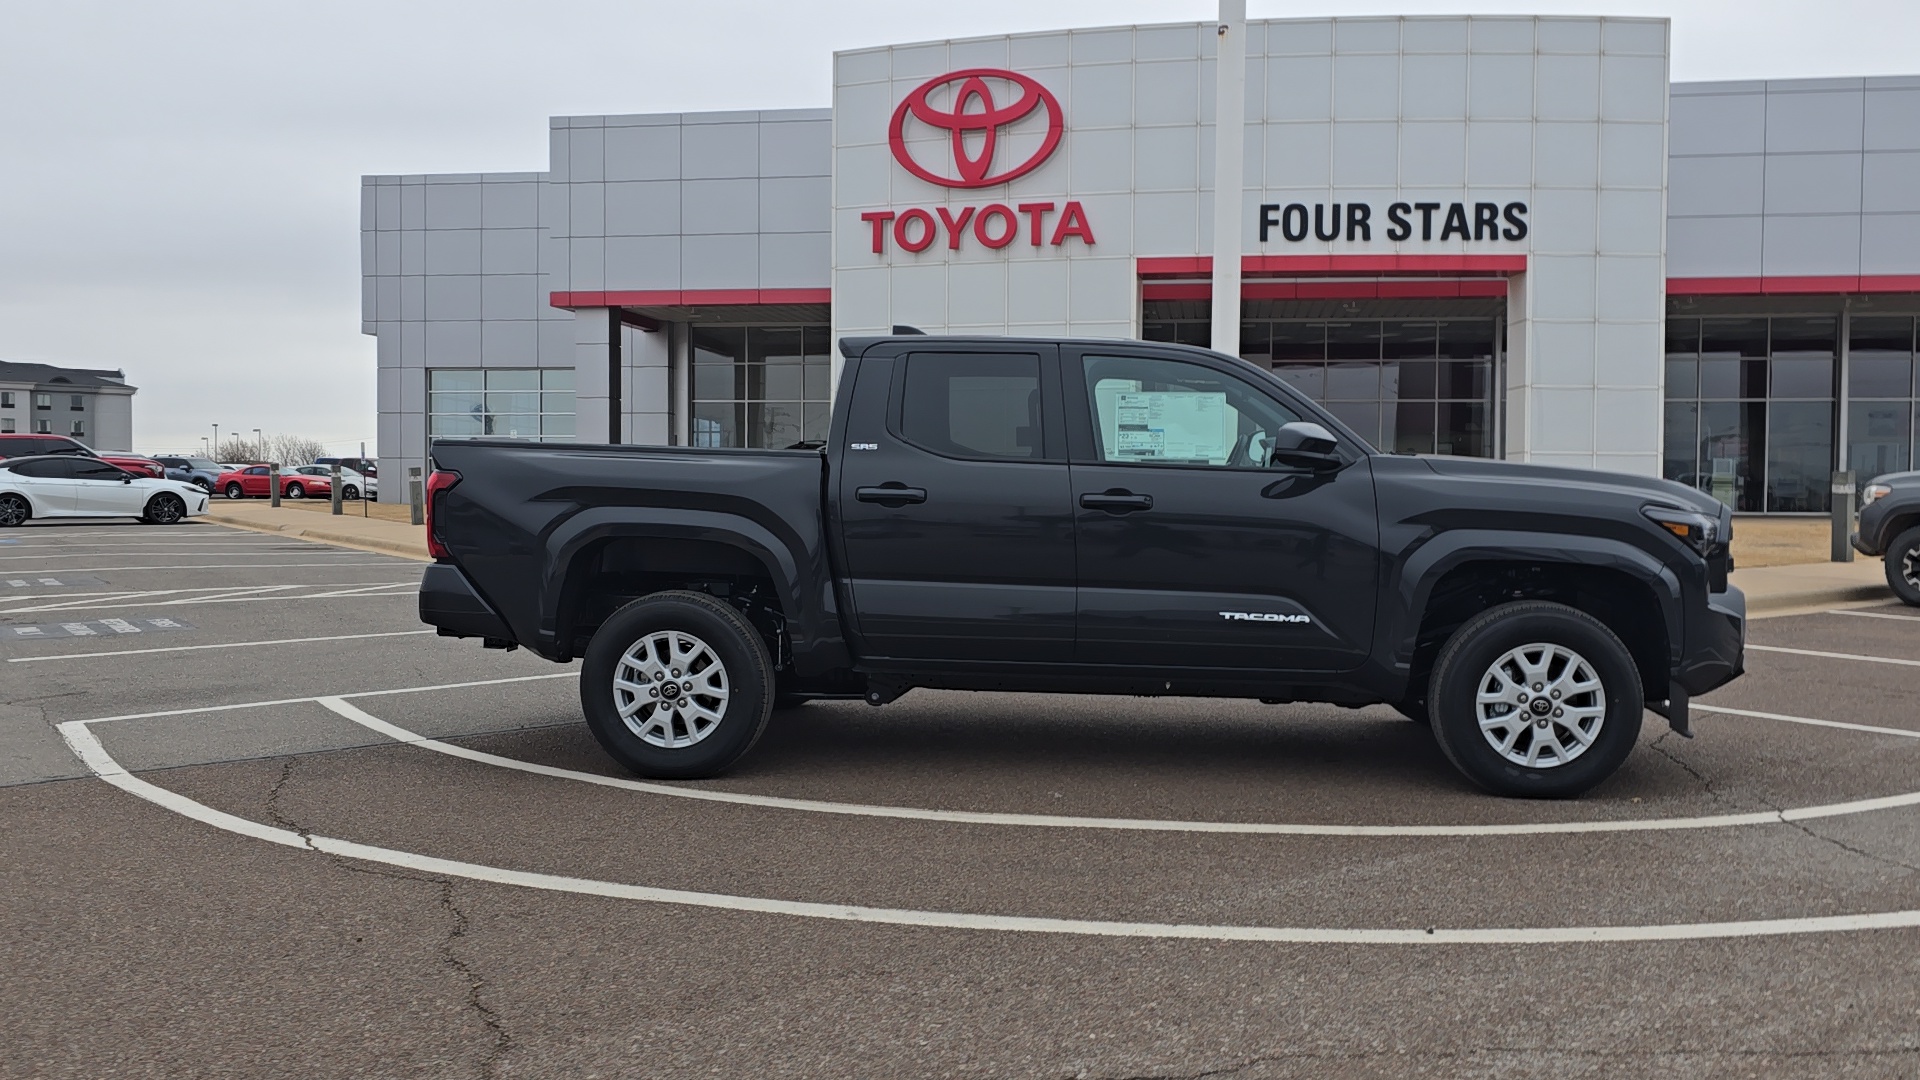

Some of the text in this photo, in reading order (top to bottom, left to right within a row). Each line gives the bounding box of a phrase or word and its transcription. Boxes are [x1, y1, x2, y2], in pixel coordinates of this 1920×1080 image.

[861, 201, 1096, 254] TOYOTA
[1259, 202, 1528, 242] FOUR STARS
[1219, 611, 1310, 623] TACOMA
